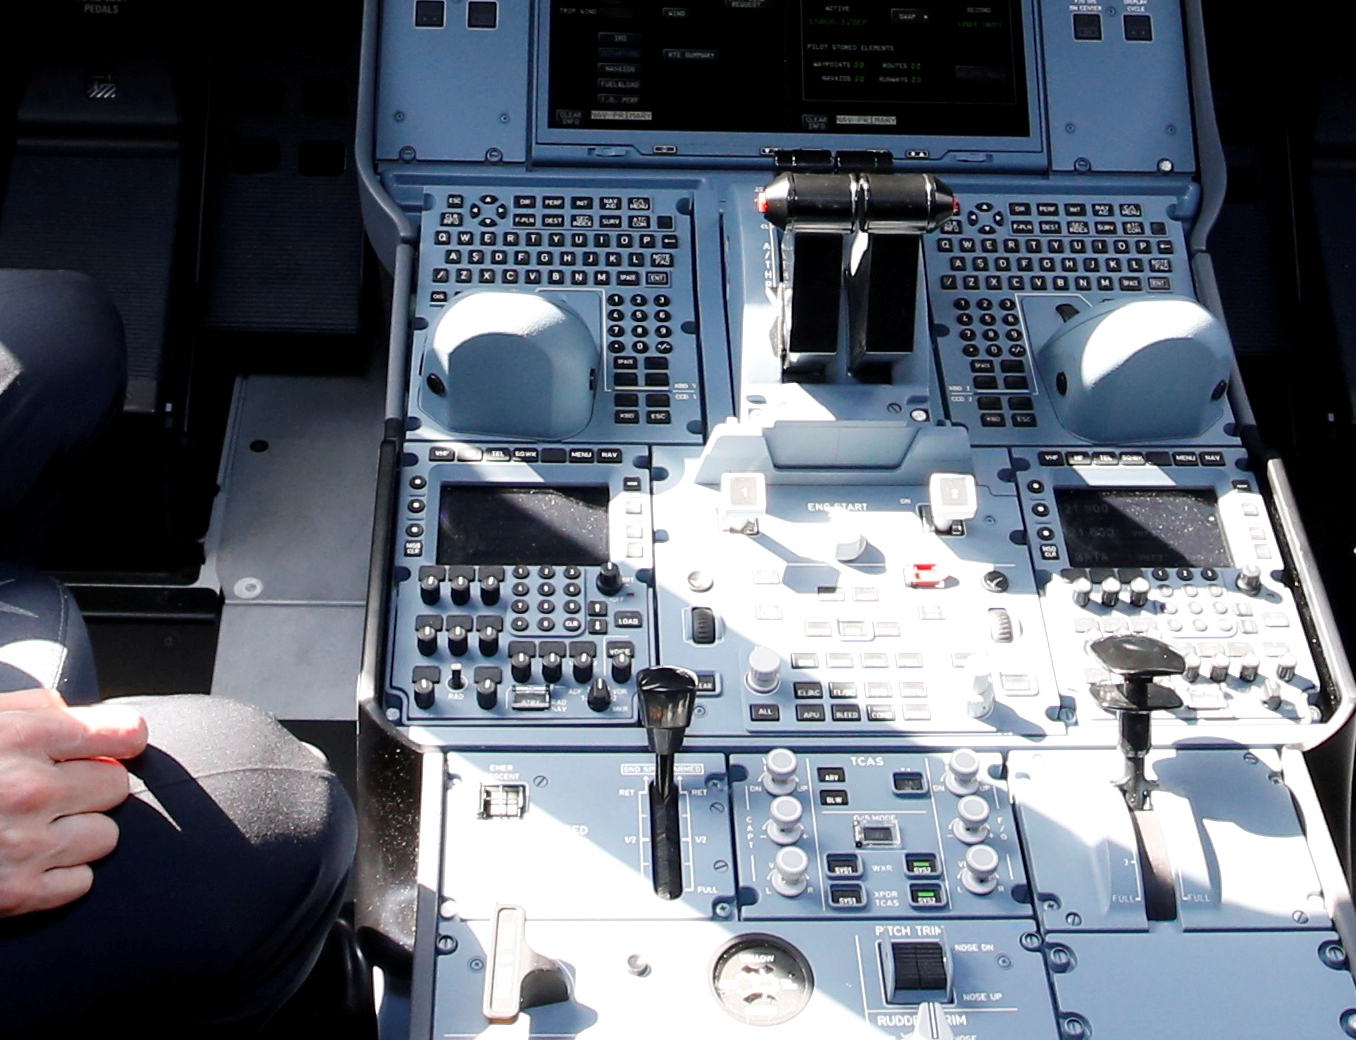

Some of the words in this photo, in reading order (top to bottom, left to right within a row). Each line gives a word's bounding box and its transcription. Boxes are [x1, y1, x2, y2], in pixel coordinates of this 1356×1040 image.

[438, 233, 446, 241] Q
[459, 234, 471, 242] W
[484, 234, 492, 242] E
[530, 235, 537, 243] T
[552, 235, 560, 243] Y
[575, 236, 583, 244] U
[620, 236, 629, 244] O
[643, 236, 651, 244] P
[449, 252, 458, 260] A
[472, 252, 479, 261] S
[495, 253, 503, 261] D
[517, 253, 525, 261] F
[540, 254, 549, 262] G
[563, 254, 572, 262] H
[609, 255, 617, 263] K
[632, 255, 639, 263] L
[460, 271, 467, 280] Z
[483, 272, 491, 280] X
[506, 272, 514, 280] C
[528, 272, 537, 280] V
[552, 273, 560, 281] B
[575, 273, 583, 282] N
[597, 273, 606, 281] M
[660, 327, 667, 335] 9
[950, 488, 960, 499] 2
[758, 707, 773, 715] ALL
[803, 711, 820, 719] APU
[835, 711, 859, 719] BLEED
[850, 756, 884, 766] TCAS
[489, 764, 514, 772] EMER
[618, 788, 635, 797] RET
[826, 796, 843, 804] BLW
[624, 836, 637, 844] 1/2
[695, 836, 707, 844] 1/2
[871, 864, 894, 872] WXR
[697, 886, 718, 894] FULL
[873, 890, 898, 898] XPDR
[1112, 894, 1134, 903] FULL
[1187, 893, 1211, 903] FULL
[874, 899, 900, 907] TCAS
[875, 925, 911, 936] PTCH
[954, 943, 979, 952] NOSE
[981, 943, 995, 952] DN
[962, 992, 988, 1001] NOSE
[989, 992, 1003, 1001] UP
[877, 1014, 918, 1027] RUDDE
